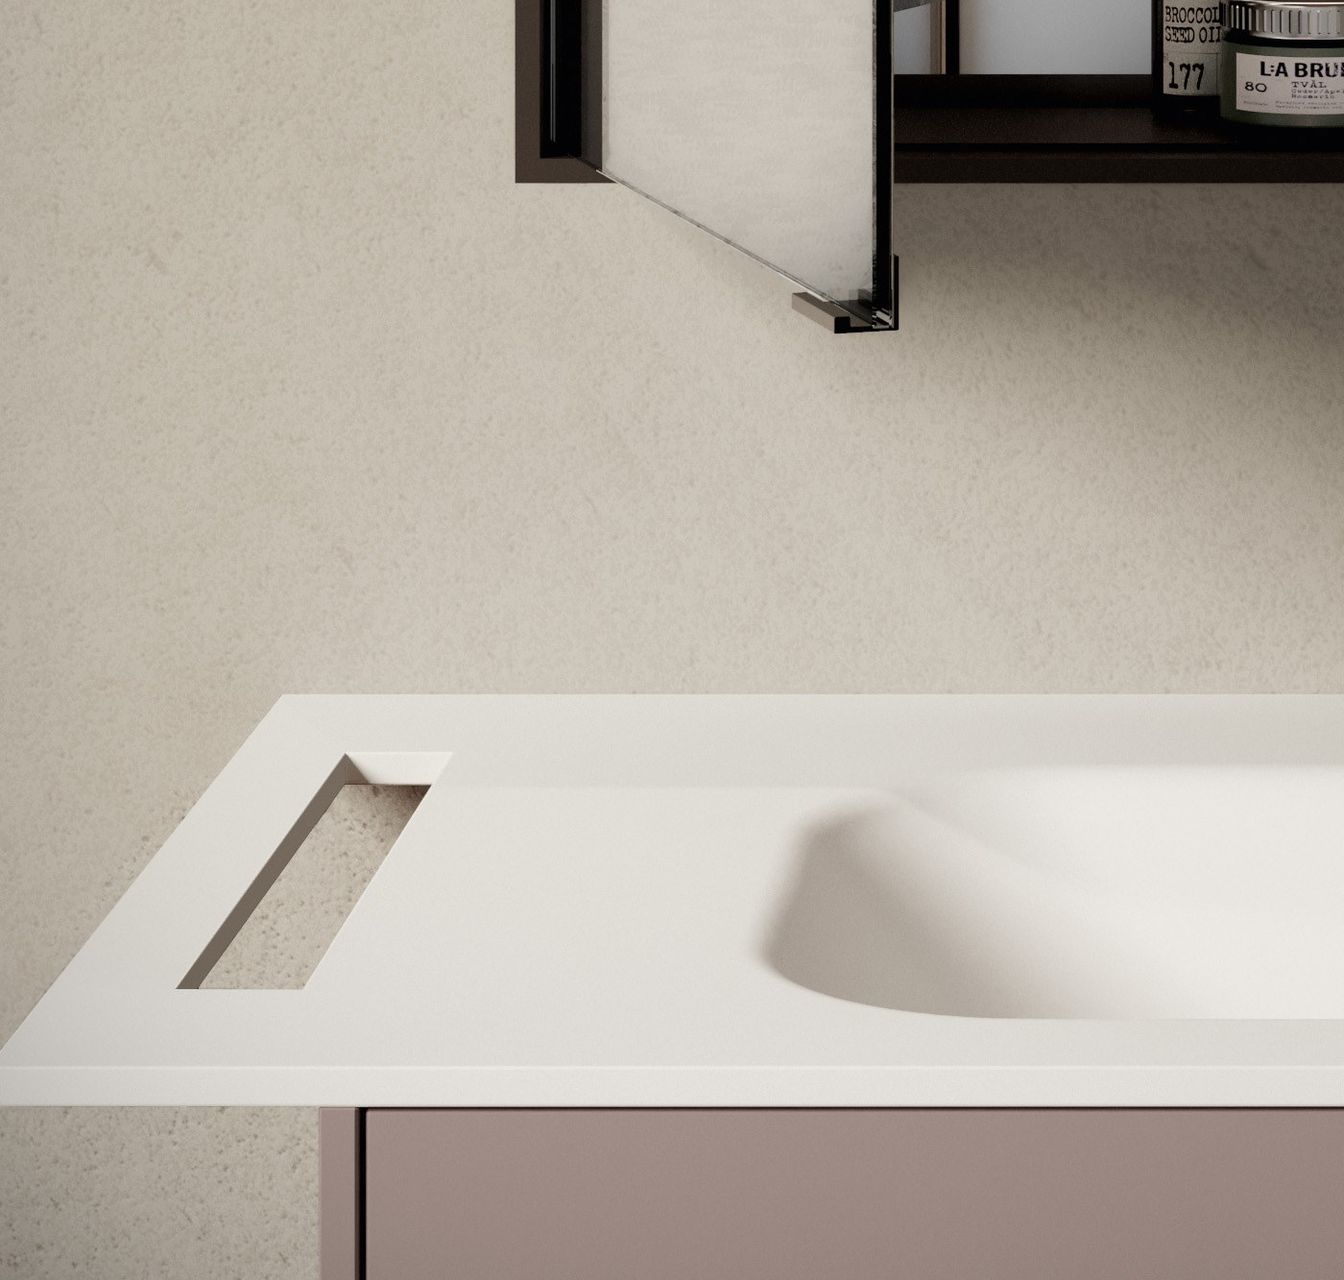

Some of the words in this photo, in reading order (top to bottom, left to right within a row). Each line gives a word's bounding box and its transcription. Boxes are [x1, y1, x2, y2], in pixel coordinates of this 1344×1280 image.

[1165, 6, 1220, 24] BROCCOL
[1165, 26, 1195, 44] SEED
[1168, 61, 1205, 90] 177
[1260, 61, 1289, 78] L:A
[1244, 81, 1267, 93] 80
